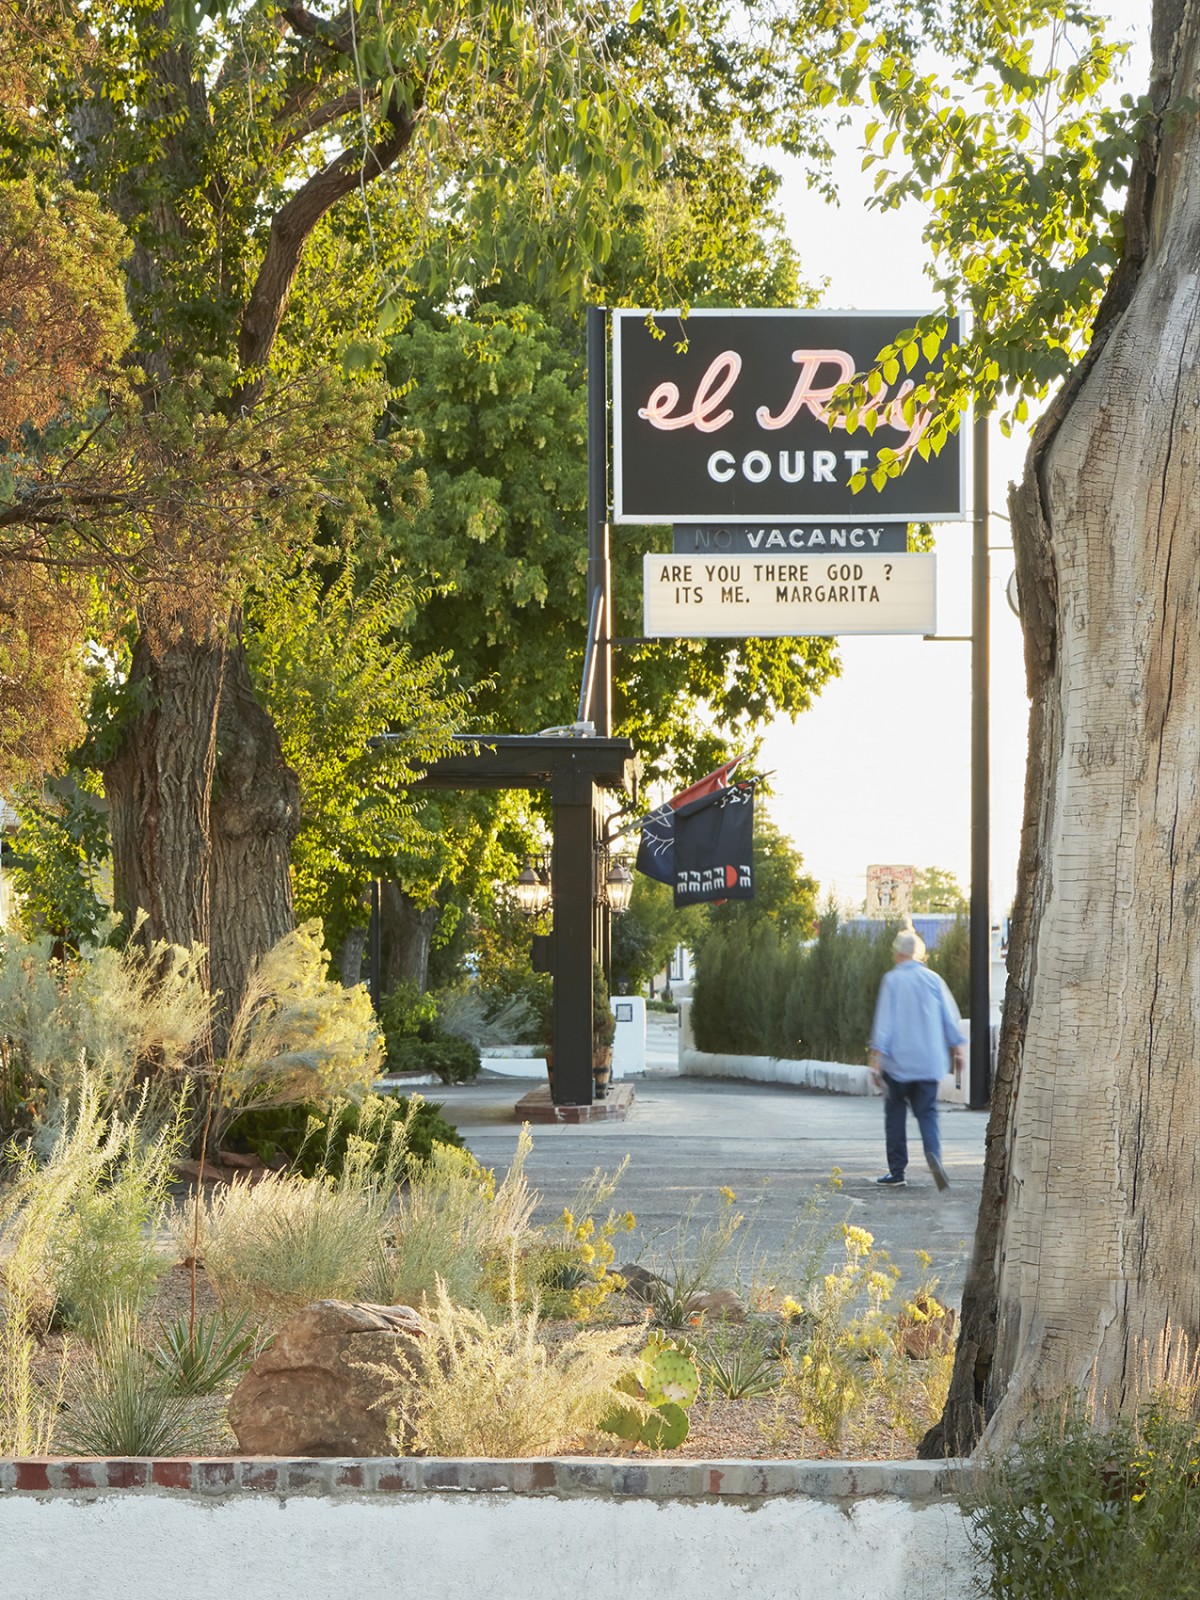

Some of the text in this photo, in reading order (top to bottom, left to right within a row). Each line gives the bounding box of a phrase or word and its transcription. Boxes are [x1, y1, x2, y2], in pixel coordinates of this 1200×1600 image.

[638, 350, 742, 433] el
[707, 450, 869, 483] COURT
[694, 528, 884, 549] NO VACANCY
[660, 563, 893, 582] ARE YOU THERE GOD ?
[675, 586, 880, 604] ITS ME. MARGARITA
